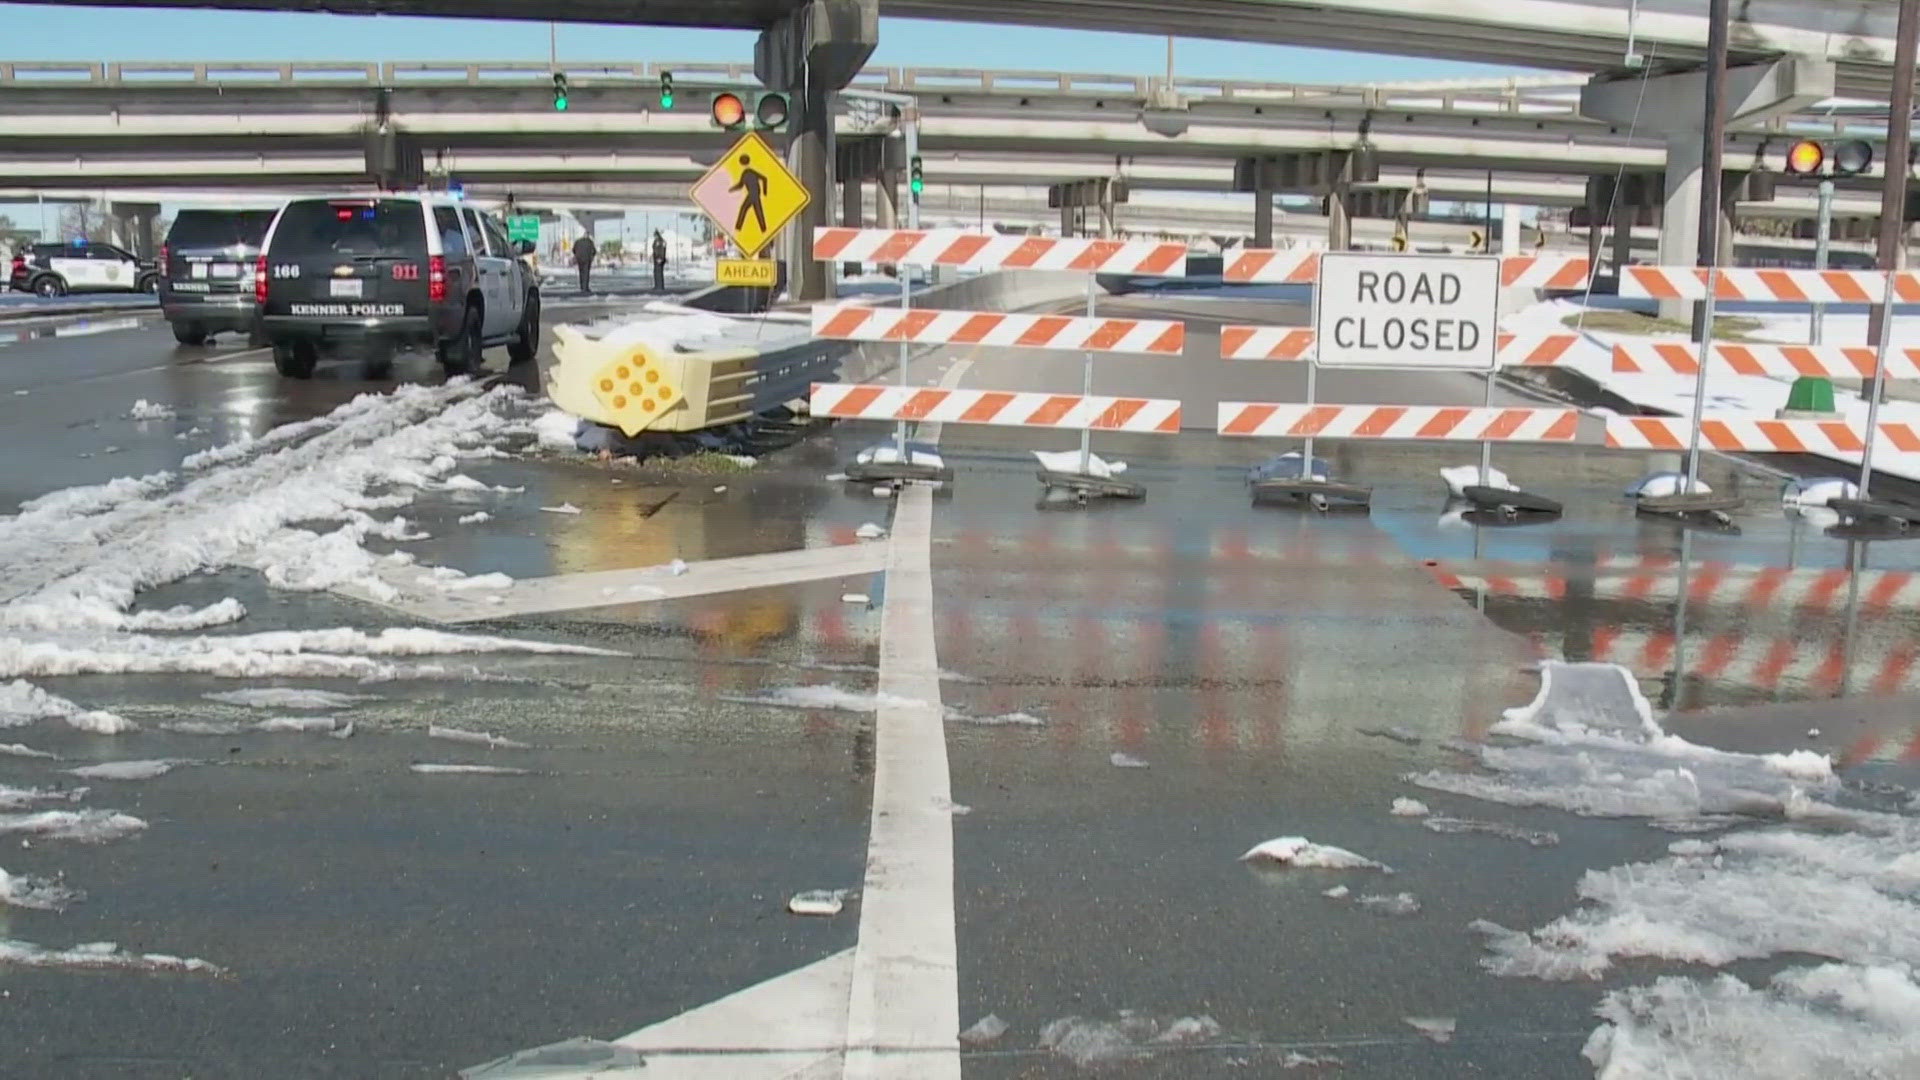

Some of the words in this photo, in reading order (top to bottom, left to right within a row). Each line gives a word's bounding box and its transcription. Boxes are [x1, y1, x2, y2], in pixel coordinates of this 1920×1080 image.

[273, 264, 300, 279] 166
[392, 264, 419, 280] 911
[724, 266, 769, 278] AHEAD
[1357, 270, 1461, 305] ROAD
[290, 303, 348, 315] KENNER
[352, 303, 405, 315] POLICE
[1334, 317, 1480, 352] CLOSED
